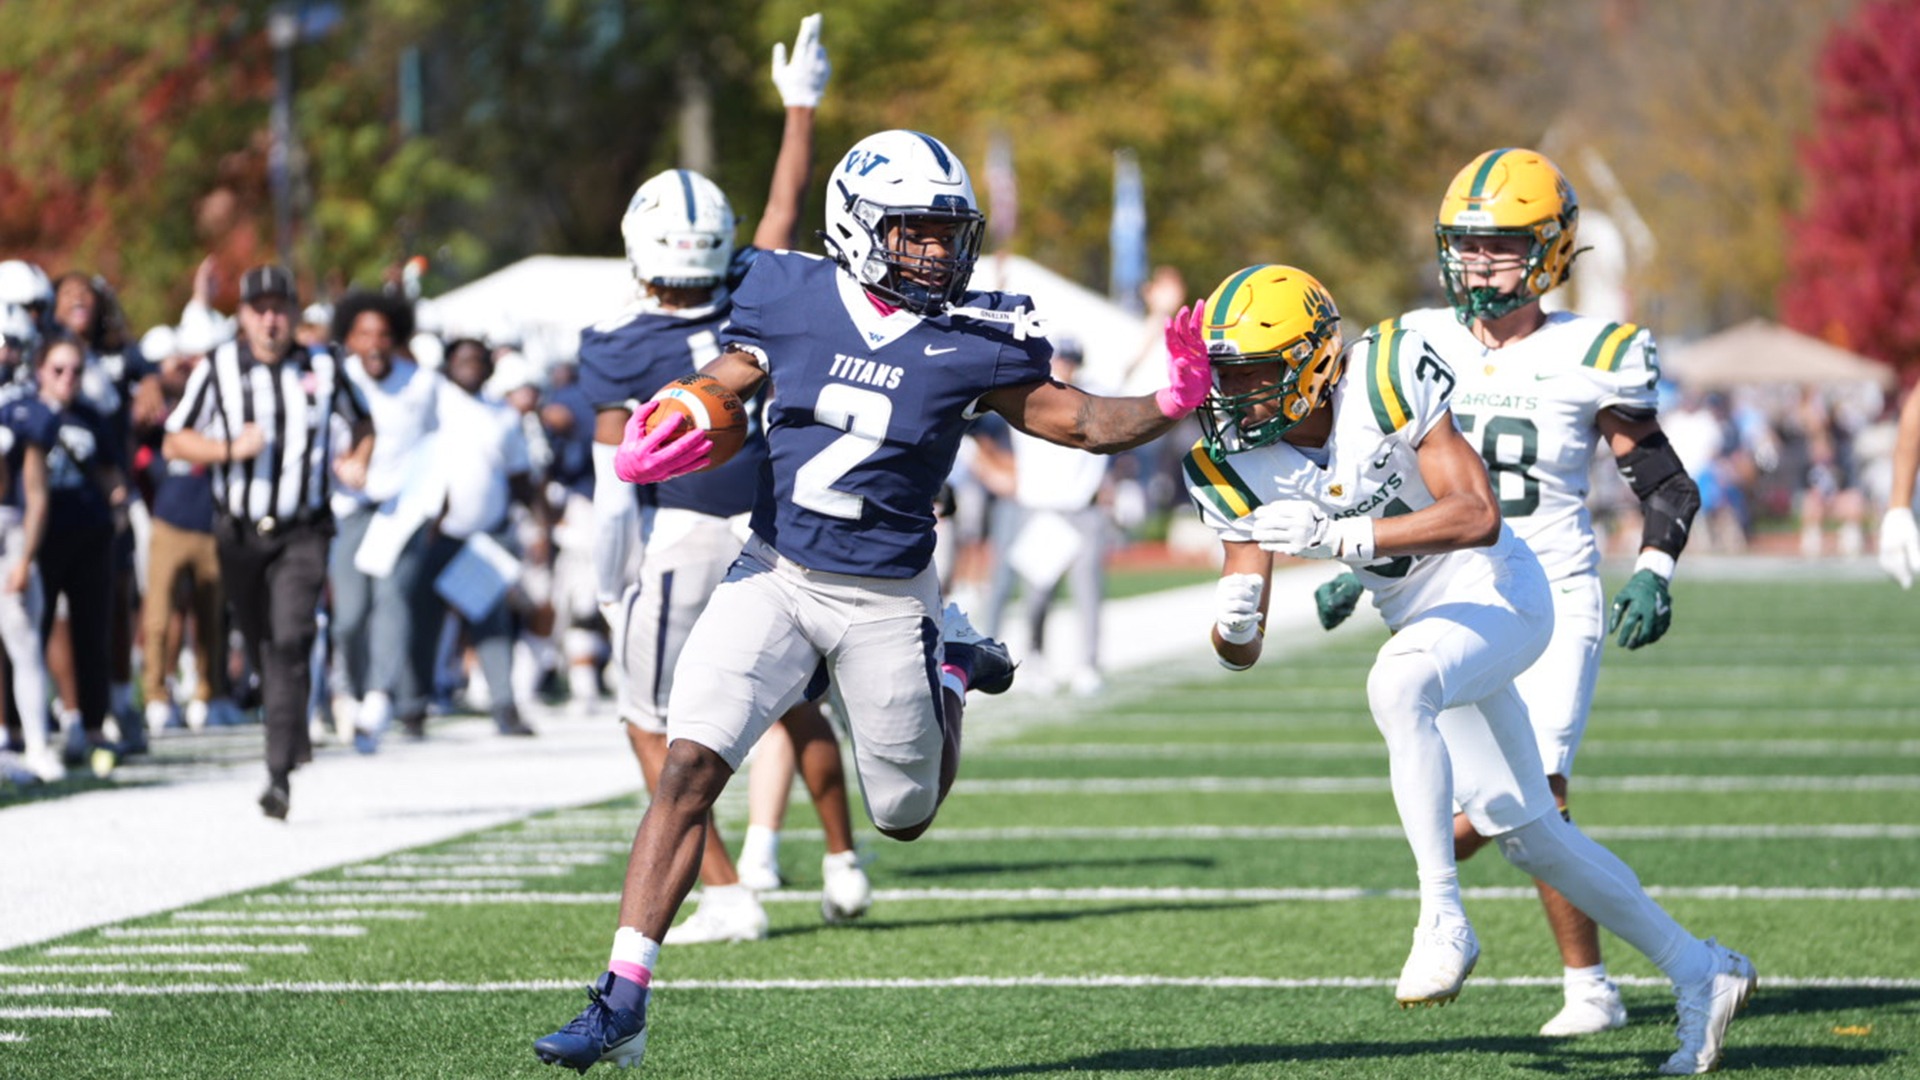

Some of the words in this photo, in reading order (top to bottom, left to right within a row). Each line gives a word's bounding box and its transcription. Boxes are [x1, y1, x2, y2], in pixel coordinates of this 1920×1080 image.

[845, 150, 890, 177] W
[828, 353, 905, 390] TITANS
[1415, 340, 1456, 402] 31
[791, 383, 893, 521] 2
